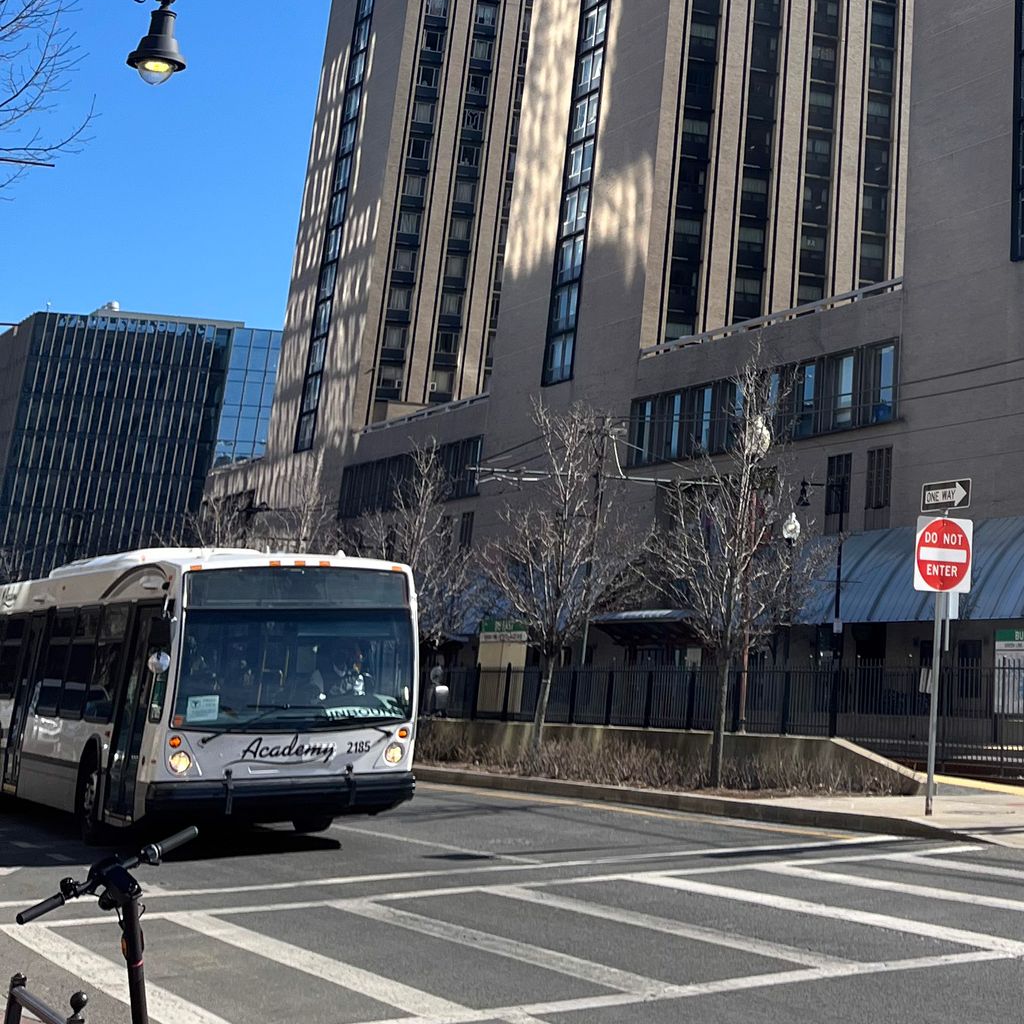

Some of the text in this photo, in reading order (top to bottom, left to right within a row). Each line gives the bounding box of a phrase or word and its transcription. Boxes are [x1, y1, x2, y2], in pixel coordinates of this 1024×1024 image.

[926, 489, 957, 503] ONE WAY
[924, 531, 963, 546] DO NOT
[926, 563, 958, 577] ENTER
[241, 732, 336, 763] Academy
[346, 740, 371, 753] 2185
